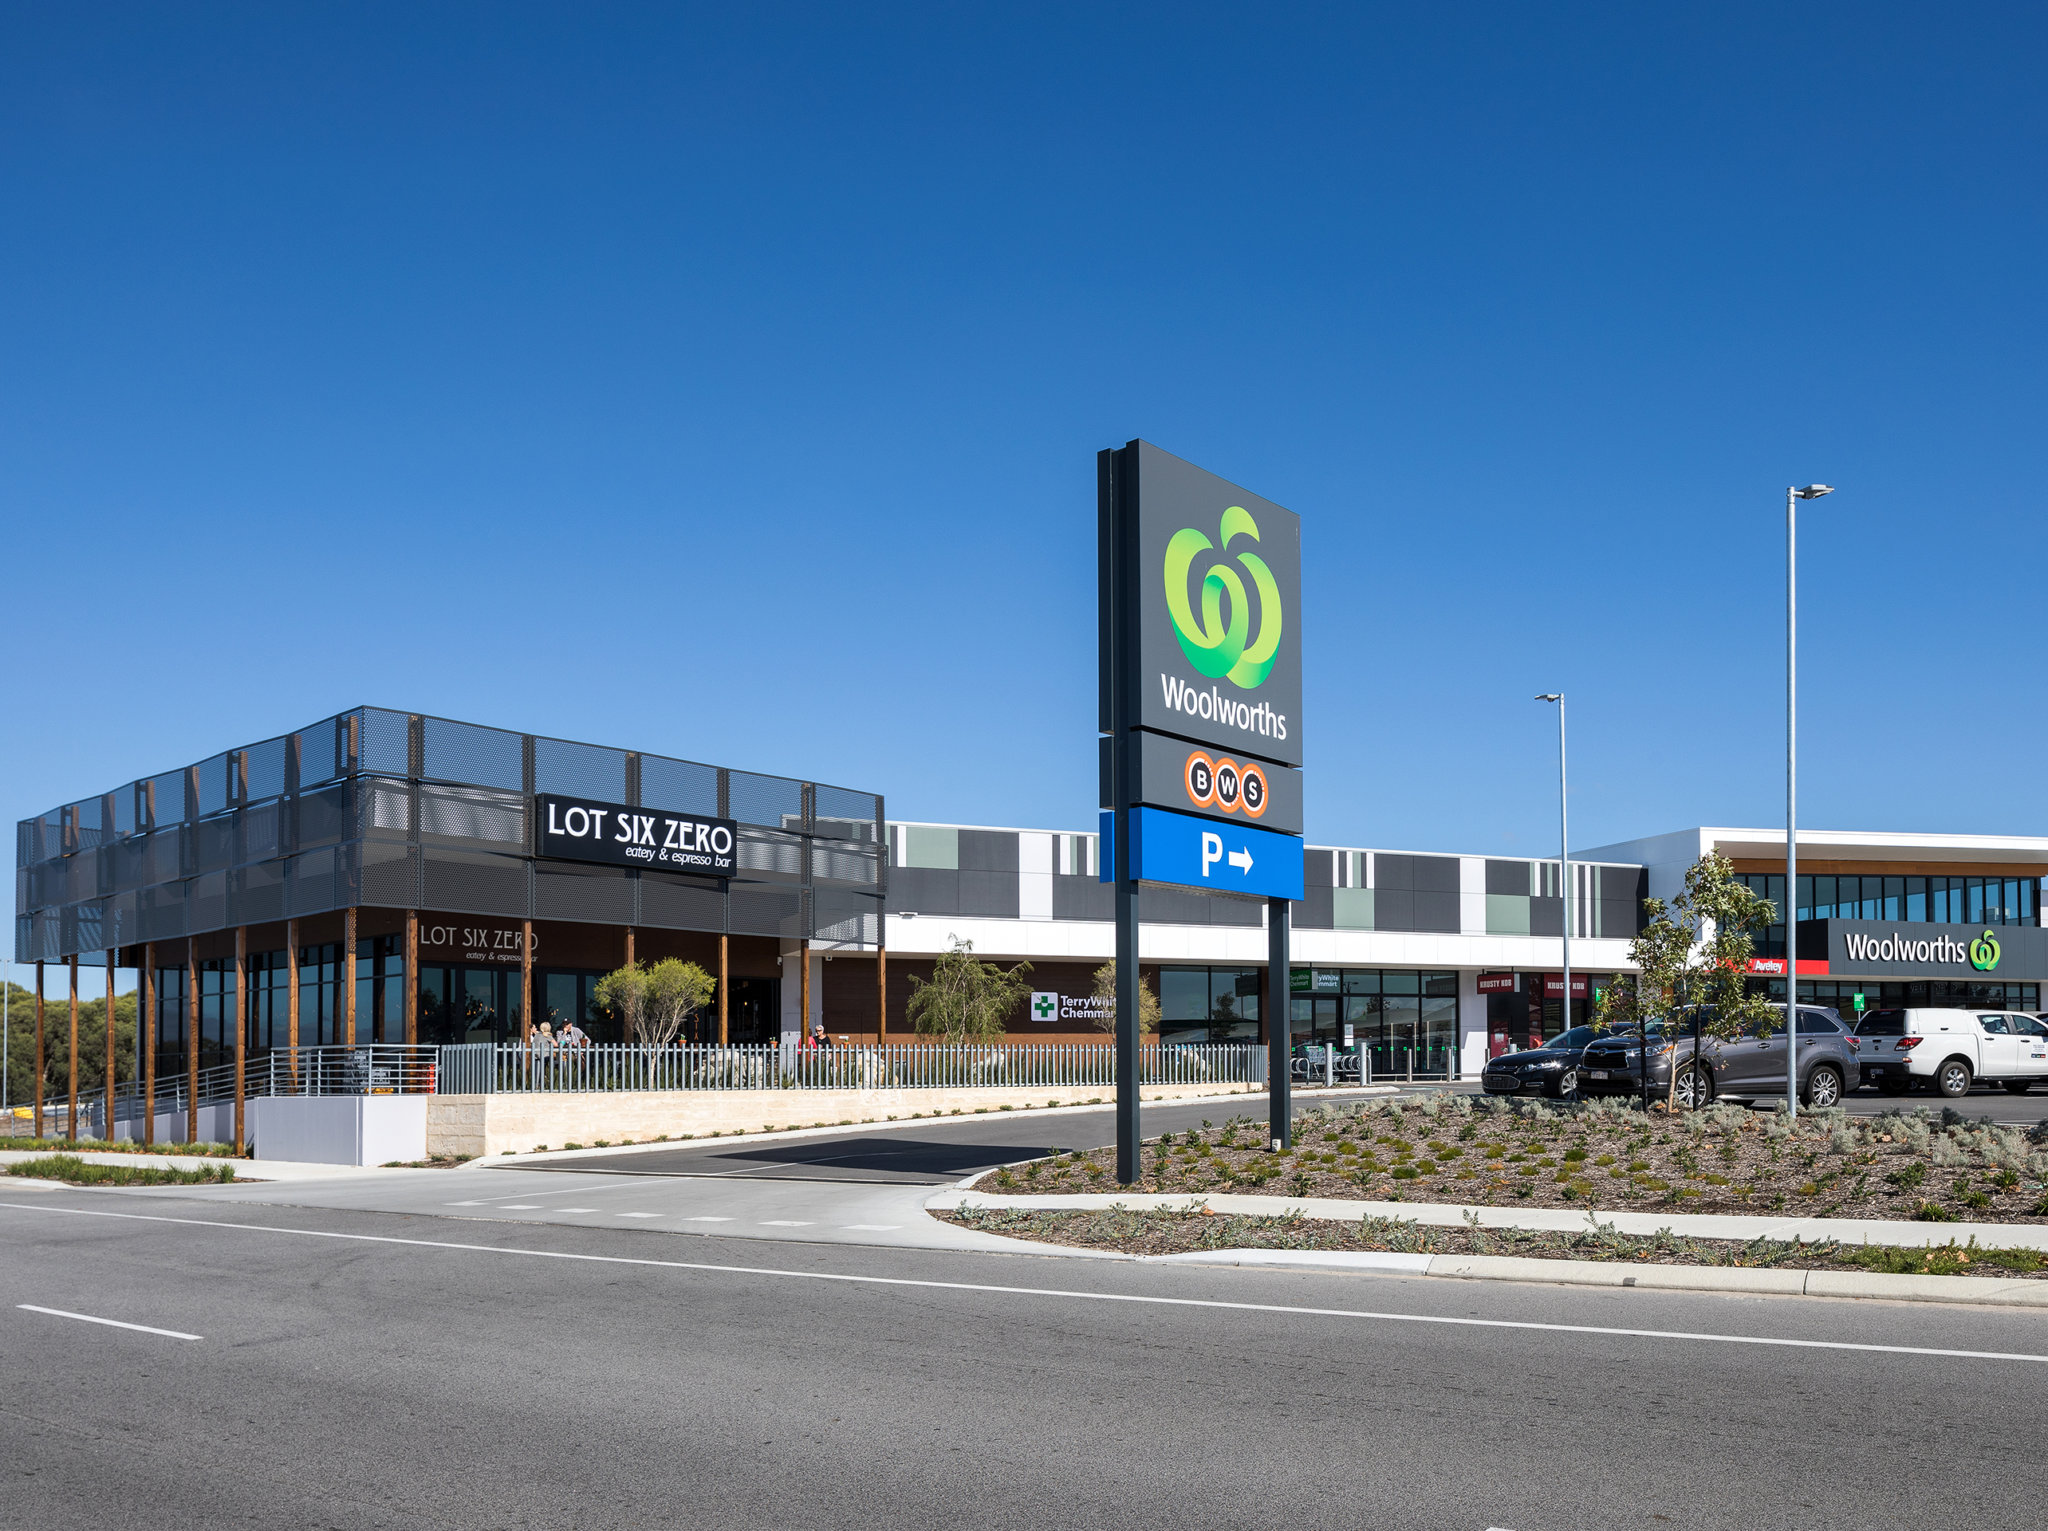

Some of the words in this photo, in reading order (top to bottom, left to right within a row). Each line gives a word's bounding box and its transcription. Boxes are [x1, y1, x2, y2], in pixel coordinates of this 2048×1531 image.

[1161, 673, 1287, 740] Woolworths
[1197, 769, 1258, 801] BWS
[548, 803, 608, 840] LOT
[614, 813, 656, 846] SIX
[663, 819, 732, 855] ZERO
[625, 846, 656, 862] eatery
[658, 848, 669, 861] &
[671, 851, 712, 866] espresso
[714, 854, 732, 868] bar
[1202, 831, 1223, 877] P
[420, 925, 457, 946] LOT
[462, 928, 488, 948] SIX
[1845, 932, 1966, 963] Woolworths
[466, 952, 486, 961] eatery
[488, 952, 495, 960] &
[497, 954, 523, 962] espress
[1754, 960, 1783, 974] Aveley
[1060, 995, 1117, 1009] TerryWhit
[1060, 1007, 1115, 1019] Chemmar
